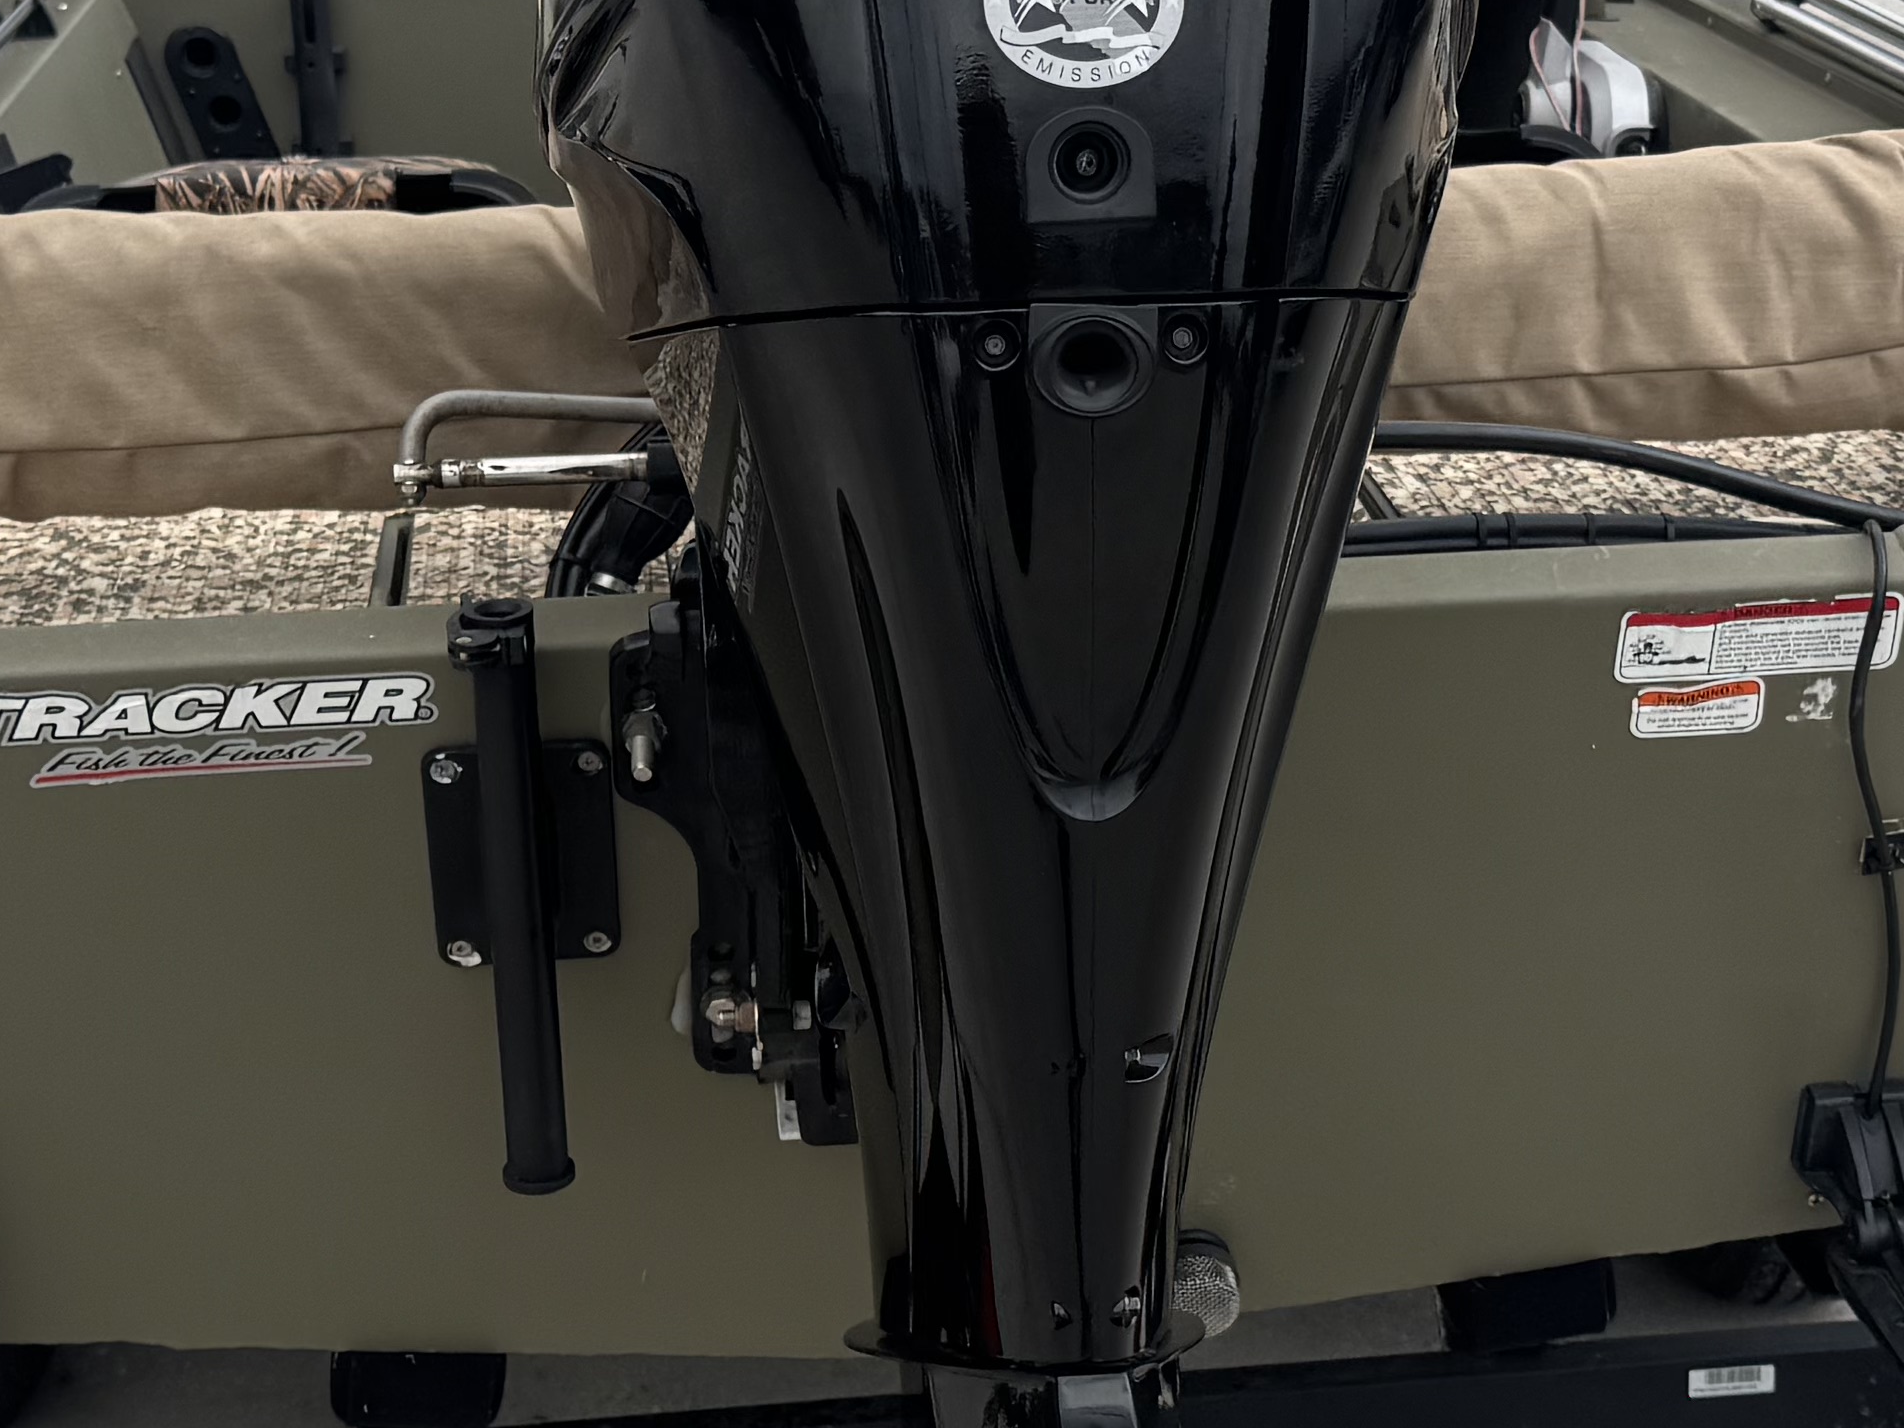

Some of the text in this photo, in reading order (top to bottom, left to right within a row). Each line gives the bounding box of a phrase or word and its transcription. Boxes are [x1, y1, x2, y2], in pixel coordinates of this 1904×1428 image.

[1021, 49, 1151, 83] EMISSION
[46, 749, 130, 772] Fish
[137, 747, 198, 767] the
